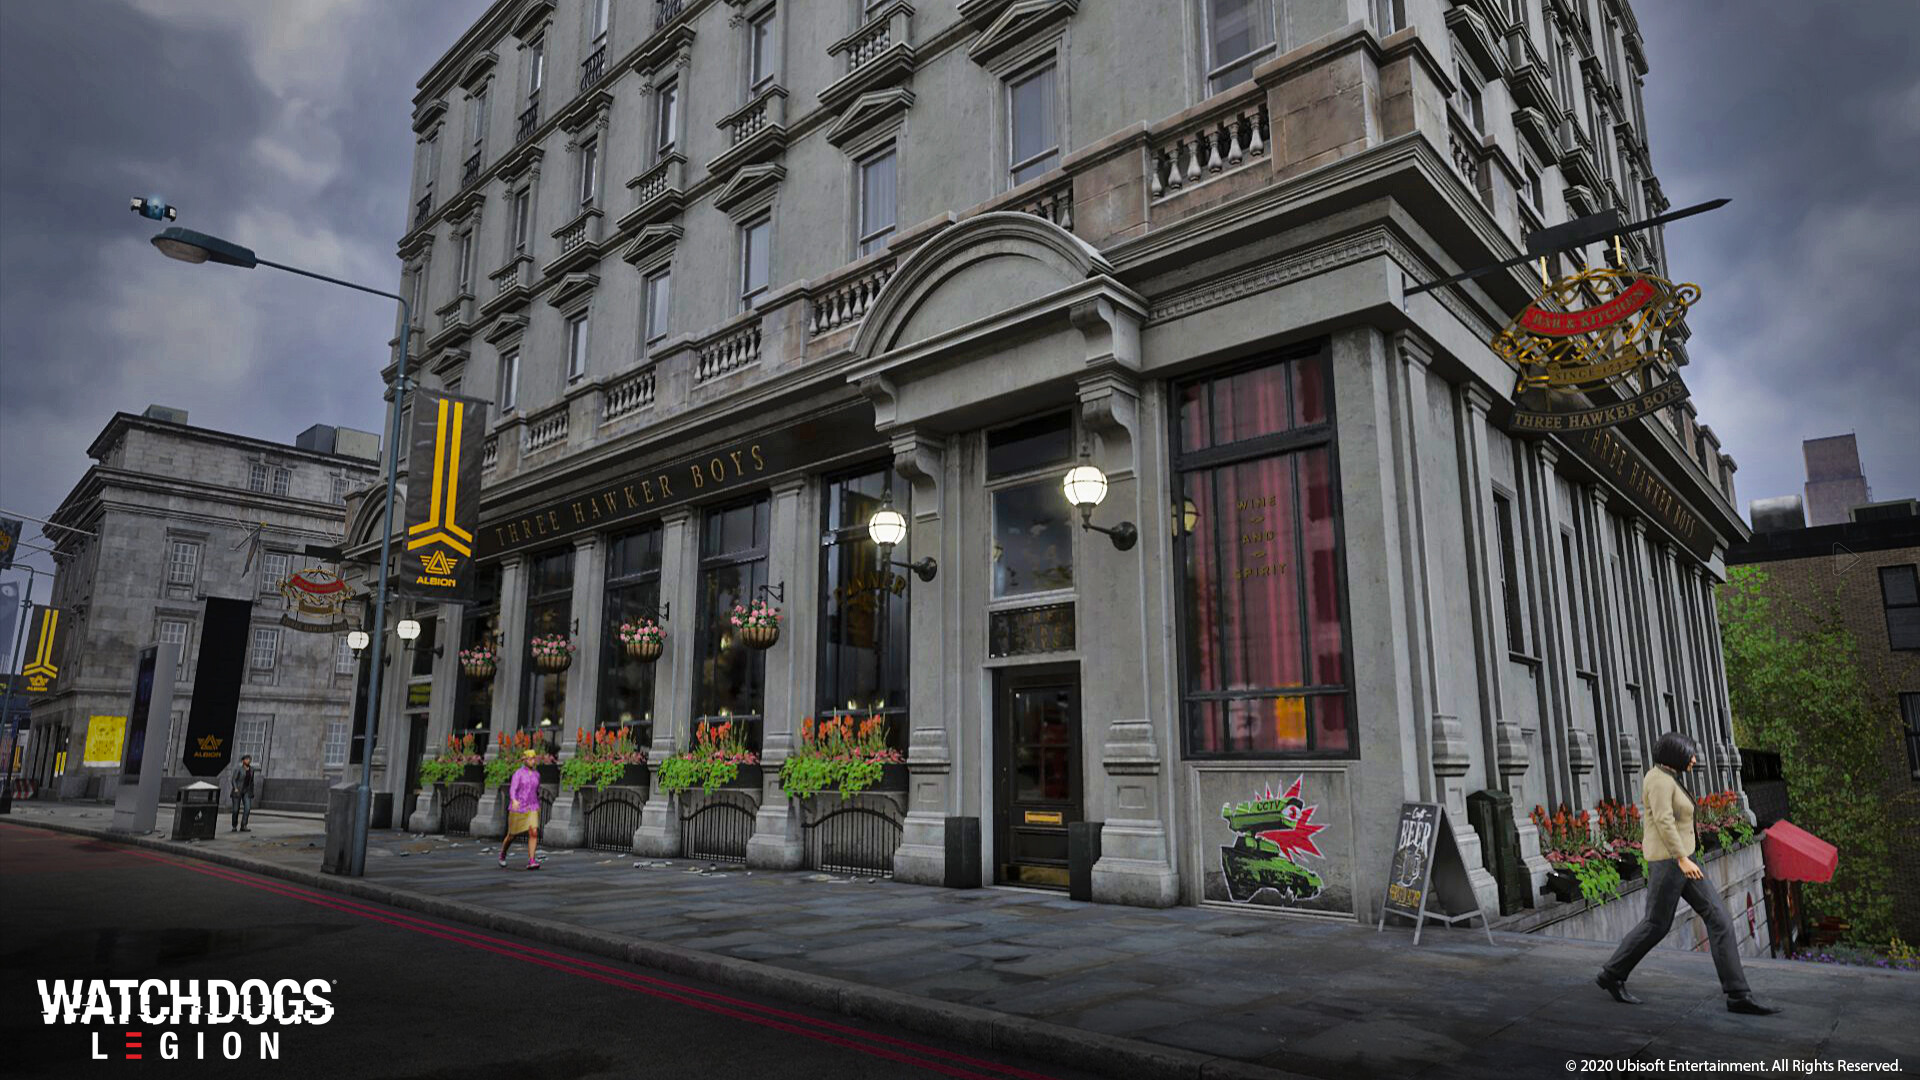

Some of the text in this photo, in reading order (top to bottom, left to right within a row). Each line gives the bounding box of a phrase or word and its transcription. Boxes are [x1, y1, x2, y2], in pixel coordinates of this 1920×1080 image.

[1514, 380, 1684, 429] THREE HAWKER BOYS
[495, 445, 766, 547] THREE HAWKER BOYS
[1237, 495, 1277, 511] WINE
[1242, 530, 1275, 545] AND
[416, 576, 457, 587] ALBION
[1257, 800, 1281, 811] CCTV
[1398, 819, 1432, 859] BEER
